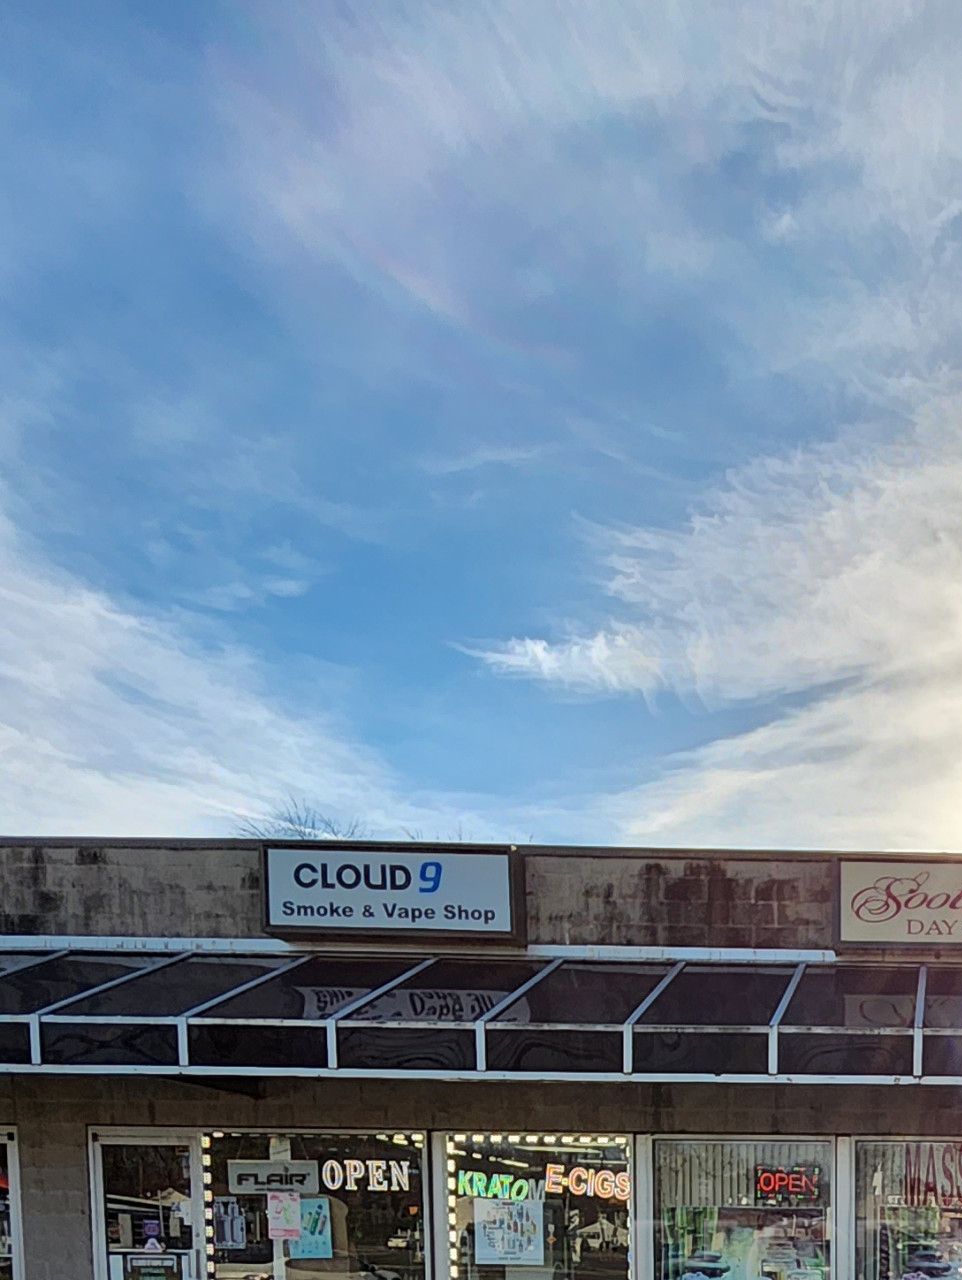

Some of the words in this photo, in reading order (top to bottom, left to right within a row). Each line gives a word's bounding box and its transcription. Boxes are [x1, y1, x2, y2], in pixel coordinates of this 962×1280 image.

[293, 862, 412, 891] CLOUD
[418, 861, 442, 893] 9
[281, 900, 354, 918] Smoke
[361, 903, 375, 918] &
[383, 902, 436, 923] Vape
[443, 904, 496, 925] Shop
[907, 919, 958, 936] DAY
[322, 1159, 410, 1192] OPEN
[457, 1169, 546, 1203] KRATOM
[759, 1172, 817, 1193] OPEN
